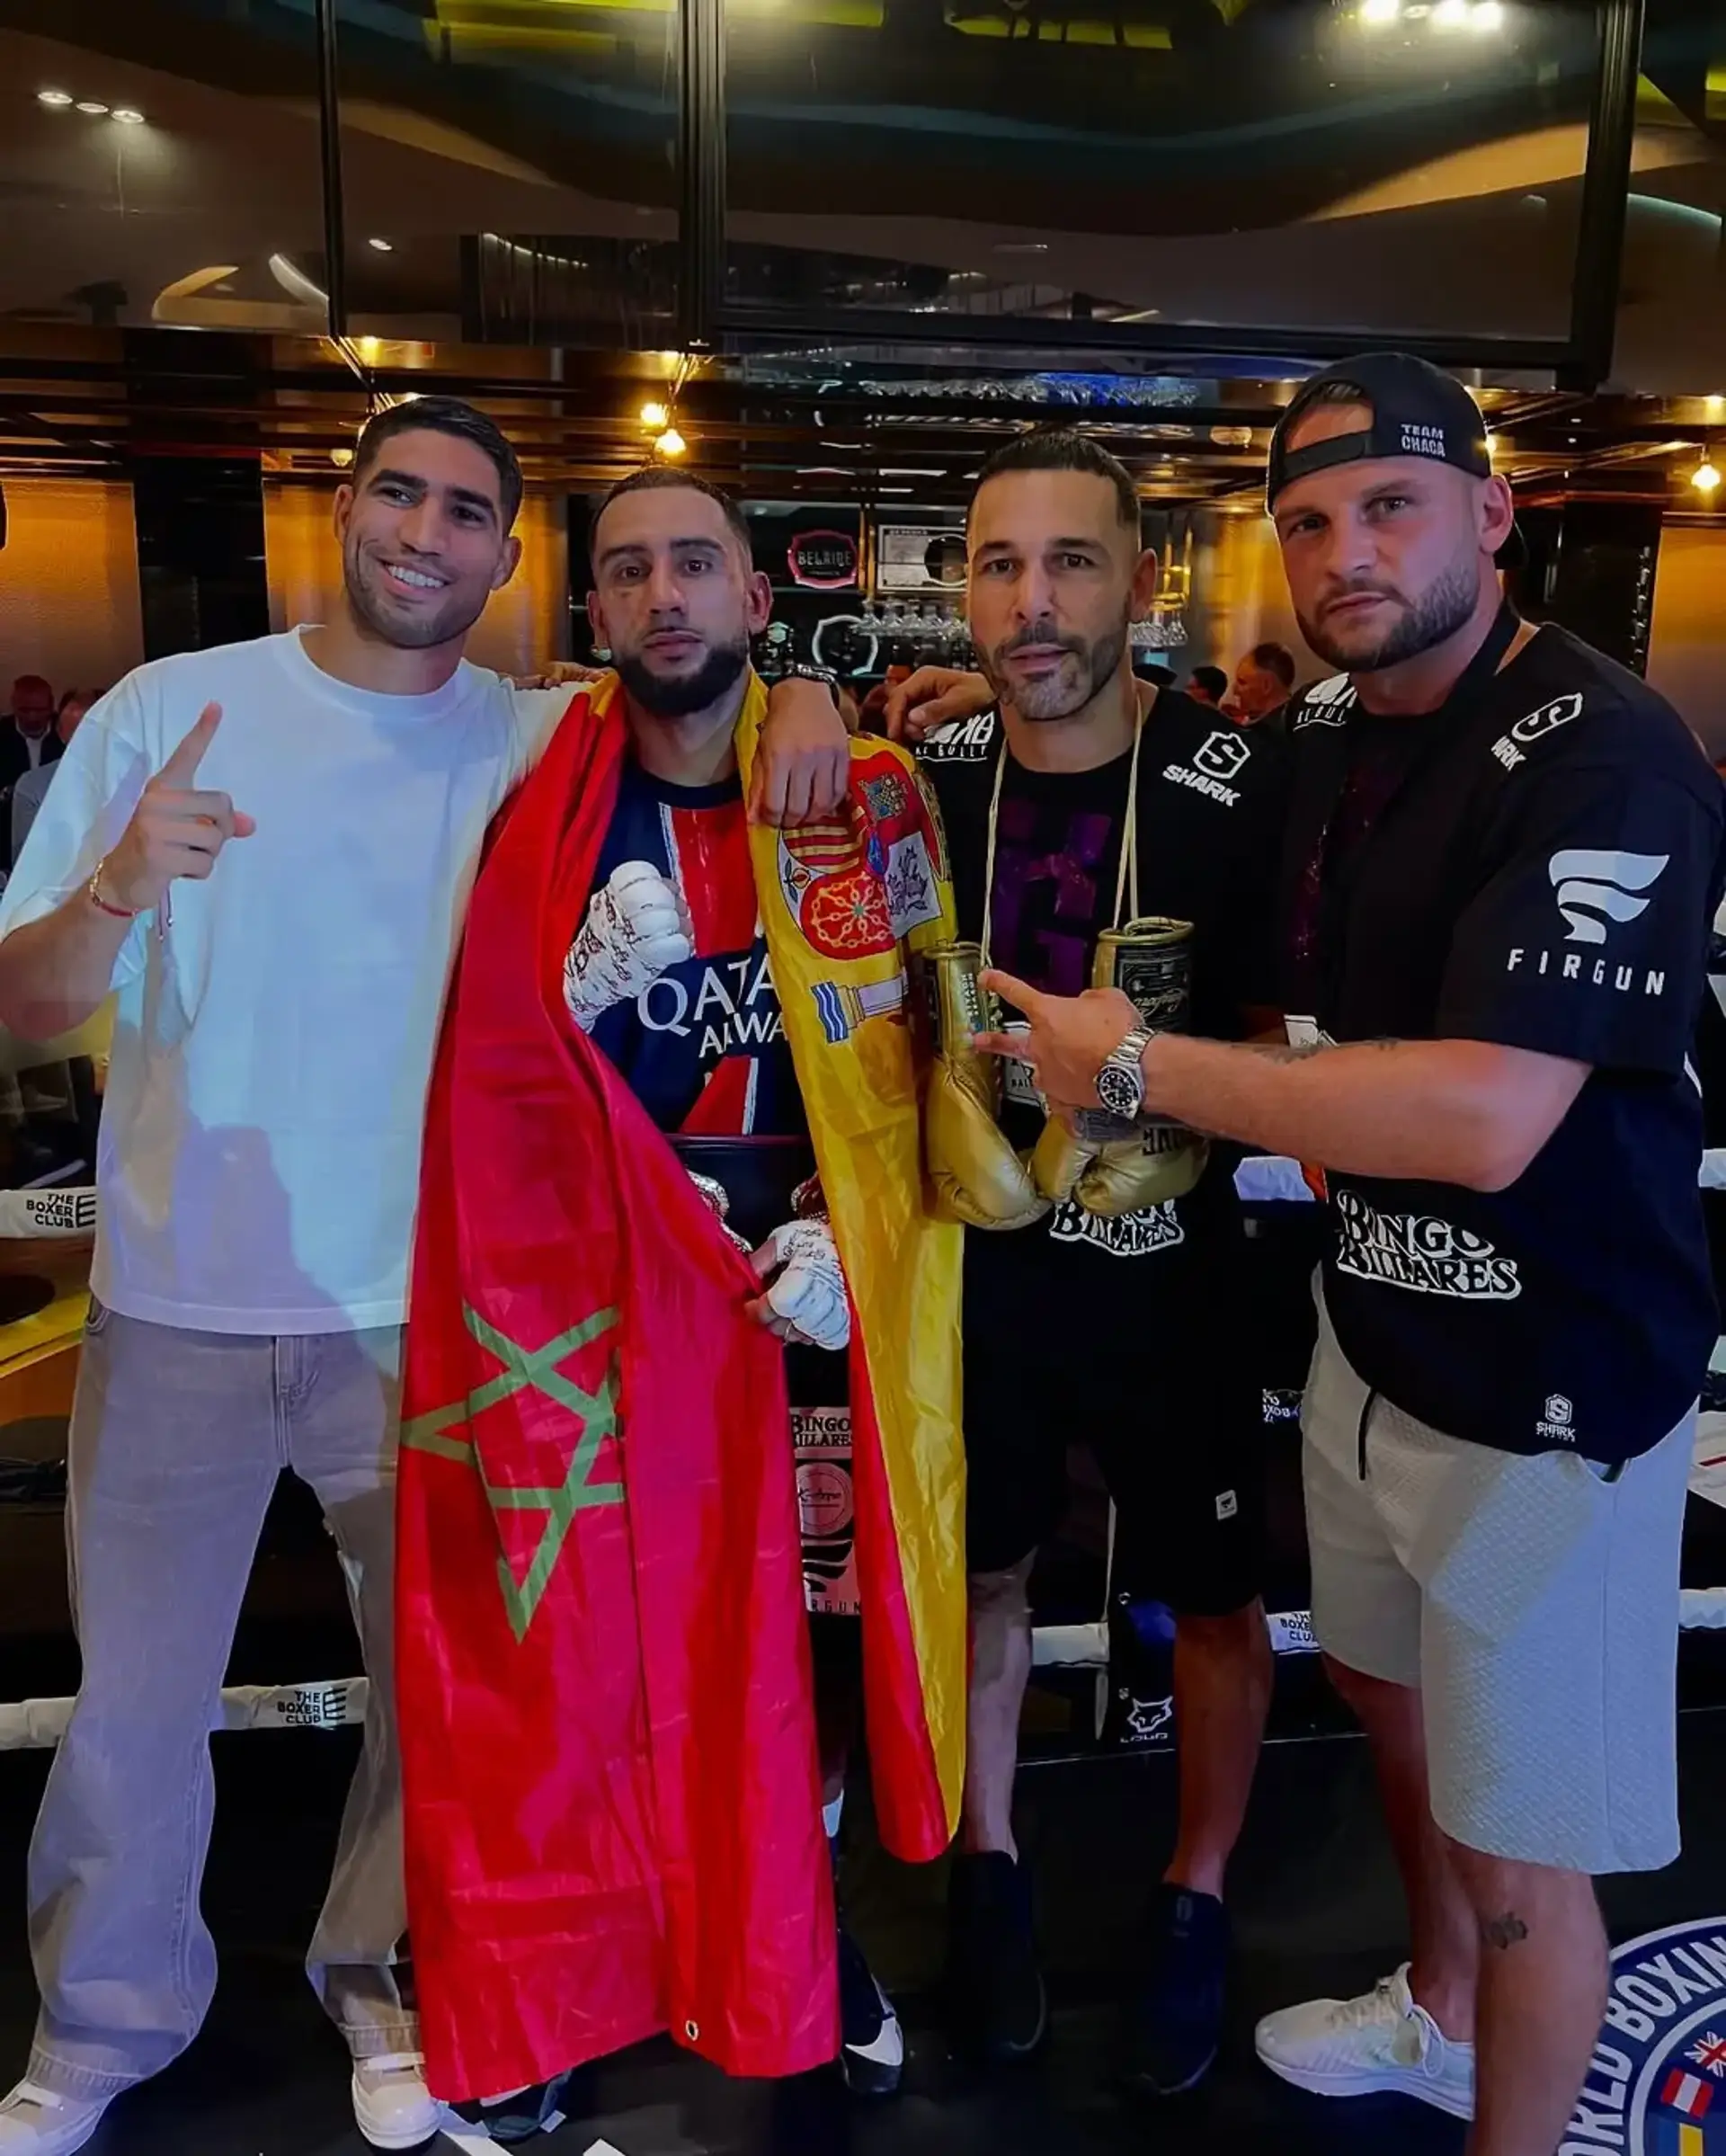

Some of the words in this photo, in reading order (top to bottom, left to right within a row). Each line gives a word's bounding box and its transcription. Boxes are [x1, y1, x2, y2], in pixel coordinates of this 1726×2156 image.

[1401, 423, 1444, 440] TEAM
[1162, 764, 1241, 806] SHARK
[1507, 949, 1665, 995] FIRGUN
[637, 953, 782, 1037] QATA
[27, 1199, 73, 1216] BOXER
[48, 1193, 74, 1205] THE
[35, 1214, 74, 1228] CLUB
[1337, 1189, 1495, 1259] BINGO
[791, 1415, 850, 1433] BINGO
[1536, 1421, 1575, 1442] SHARK
[810, 1599, 861, 1612] RGUN
[1280, 1617, 1310, 1631] BOXE
[295, 1690, 321, 1703] THE
[1604, 1936, 1726, 2043] BOXIN
